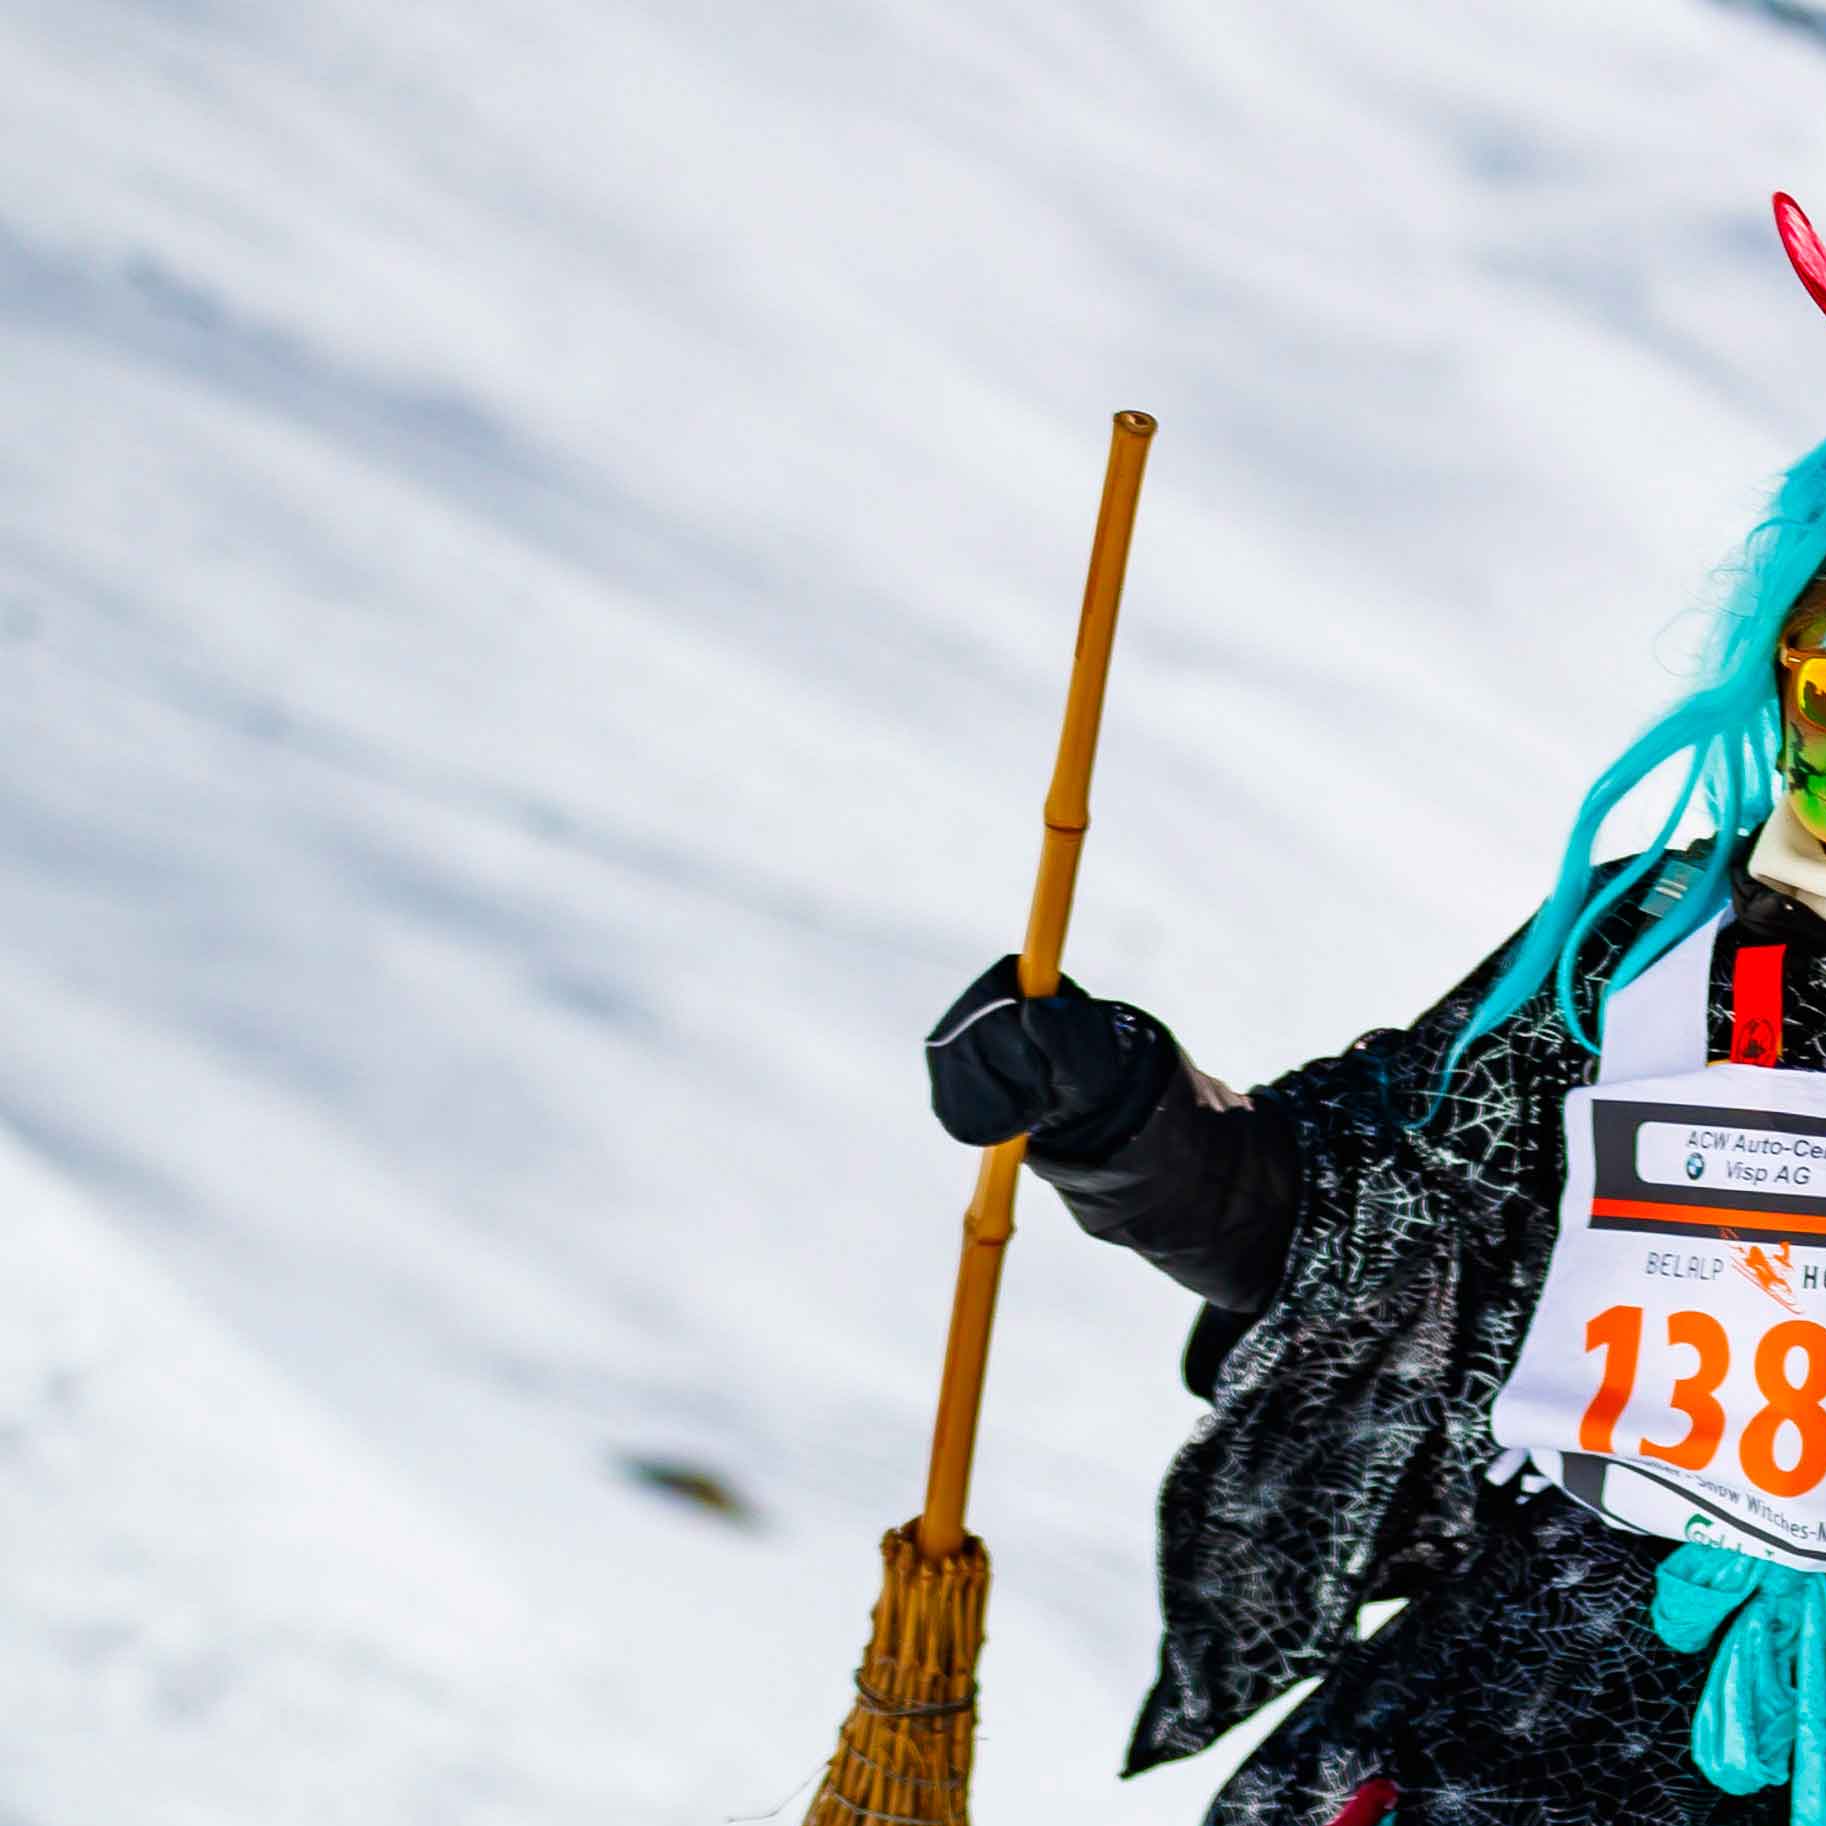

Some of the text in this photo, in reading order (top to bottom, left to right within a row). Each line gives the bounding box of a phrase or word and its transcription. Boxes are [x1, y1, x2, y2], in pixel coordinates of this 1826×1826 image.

[1685, 1130, 1730, 1150] ACW
[1726, 1160, 1812, 1186] Visp AG
[1645, 1251, 1725, 1281] BELALP
